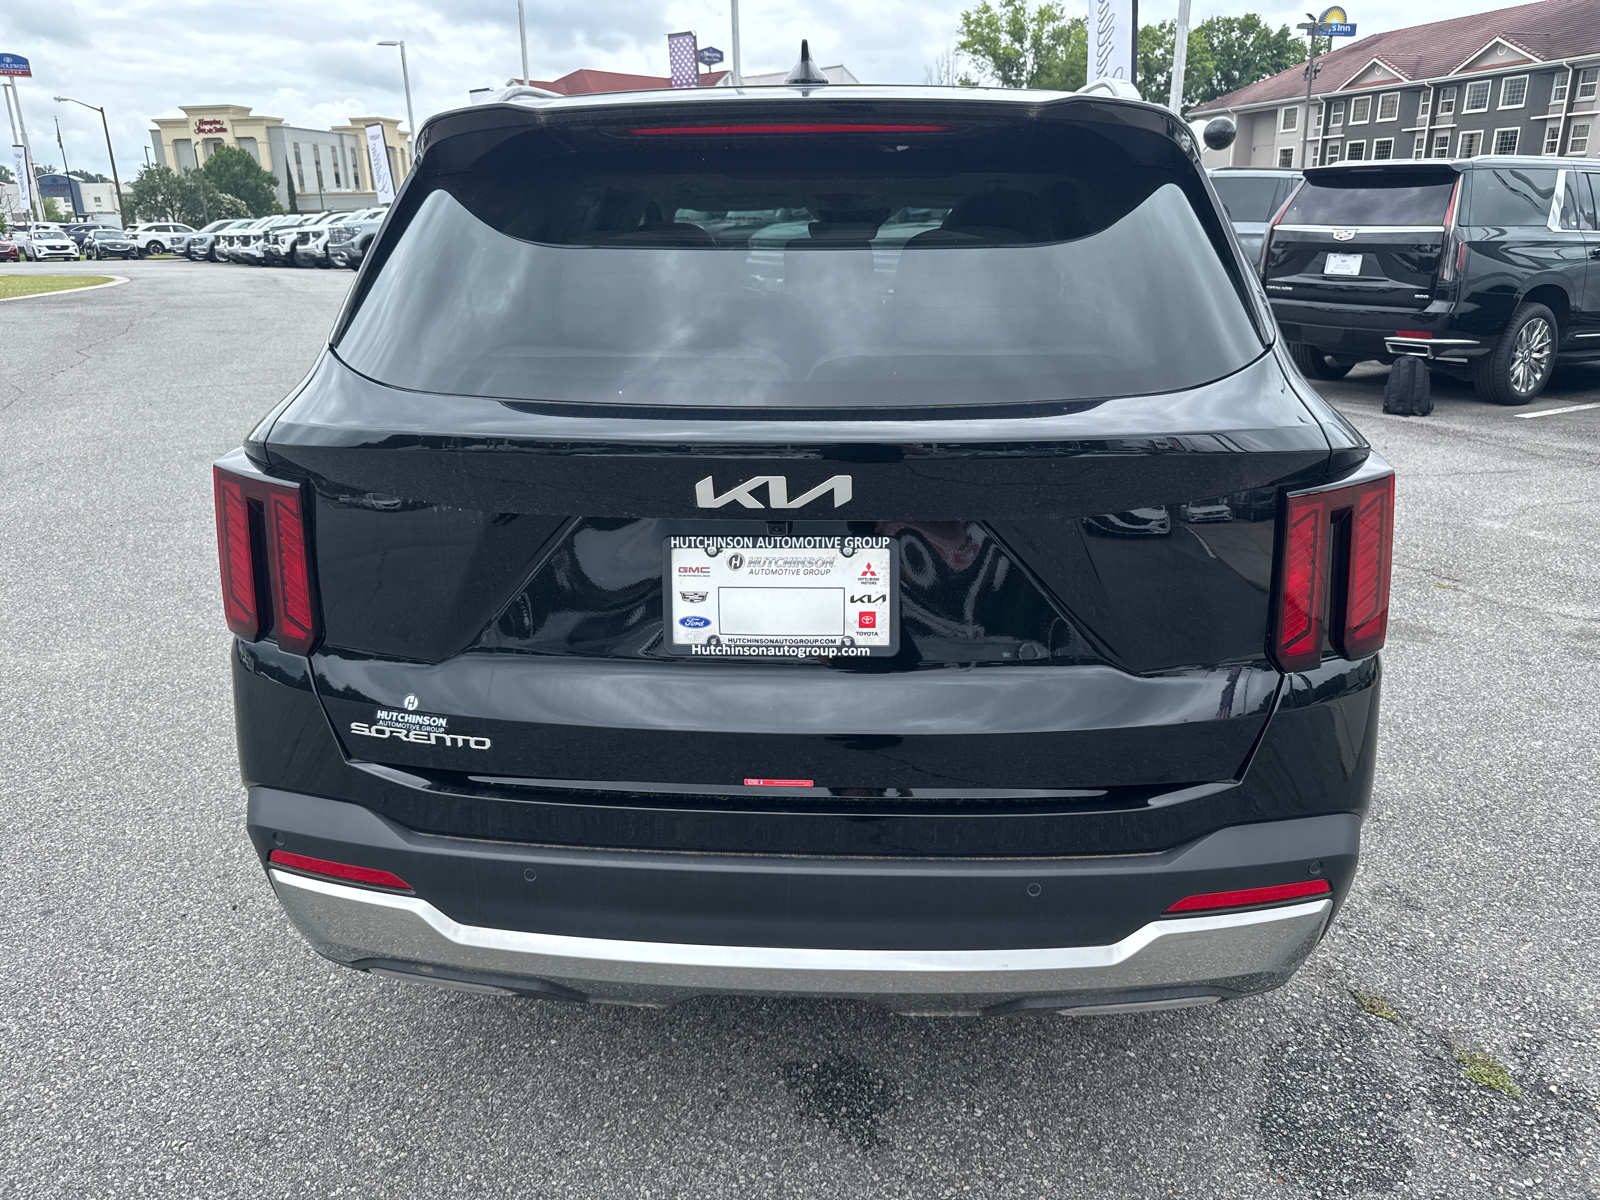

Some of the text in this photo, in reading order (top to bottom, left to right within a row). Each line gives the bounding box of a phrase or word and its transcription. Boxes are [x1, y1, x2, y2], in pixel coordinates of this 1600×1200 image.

[1337, 24, 1350, 32] Inn
[195, 118, 224, 127] Hampton
[371, 143, 389, 194] Cadillac
[695, 475, 852, 509] KIA
[670, 537, 890, 549] HUTCHINSON AUTOMOTIVE GROUP
[747, 556, 836, 569] HUTCHINSON
[850, 594, 887, 604] KIA
[683, 617, 705, 627] Ford
[727, 637, 837, 645] HUTCHINSONAUTOGROUP.COM
[691, 644, 871, 658] Hutchinsonautogroup.com
[376, 709, 448, 728] HUTCHINSON
[378, 719, 445, 733] AUTOMOTIVE GROUP
[350, 721, 492, 750] SORENTO
